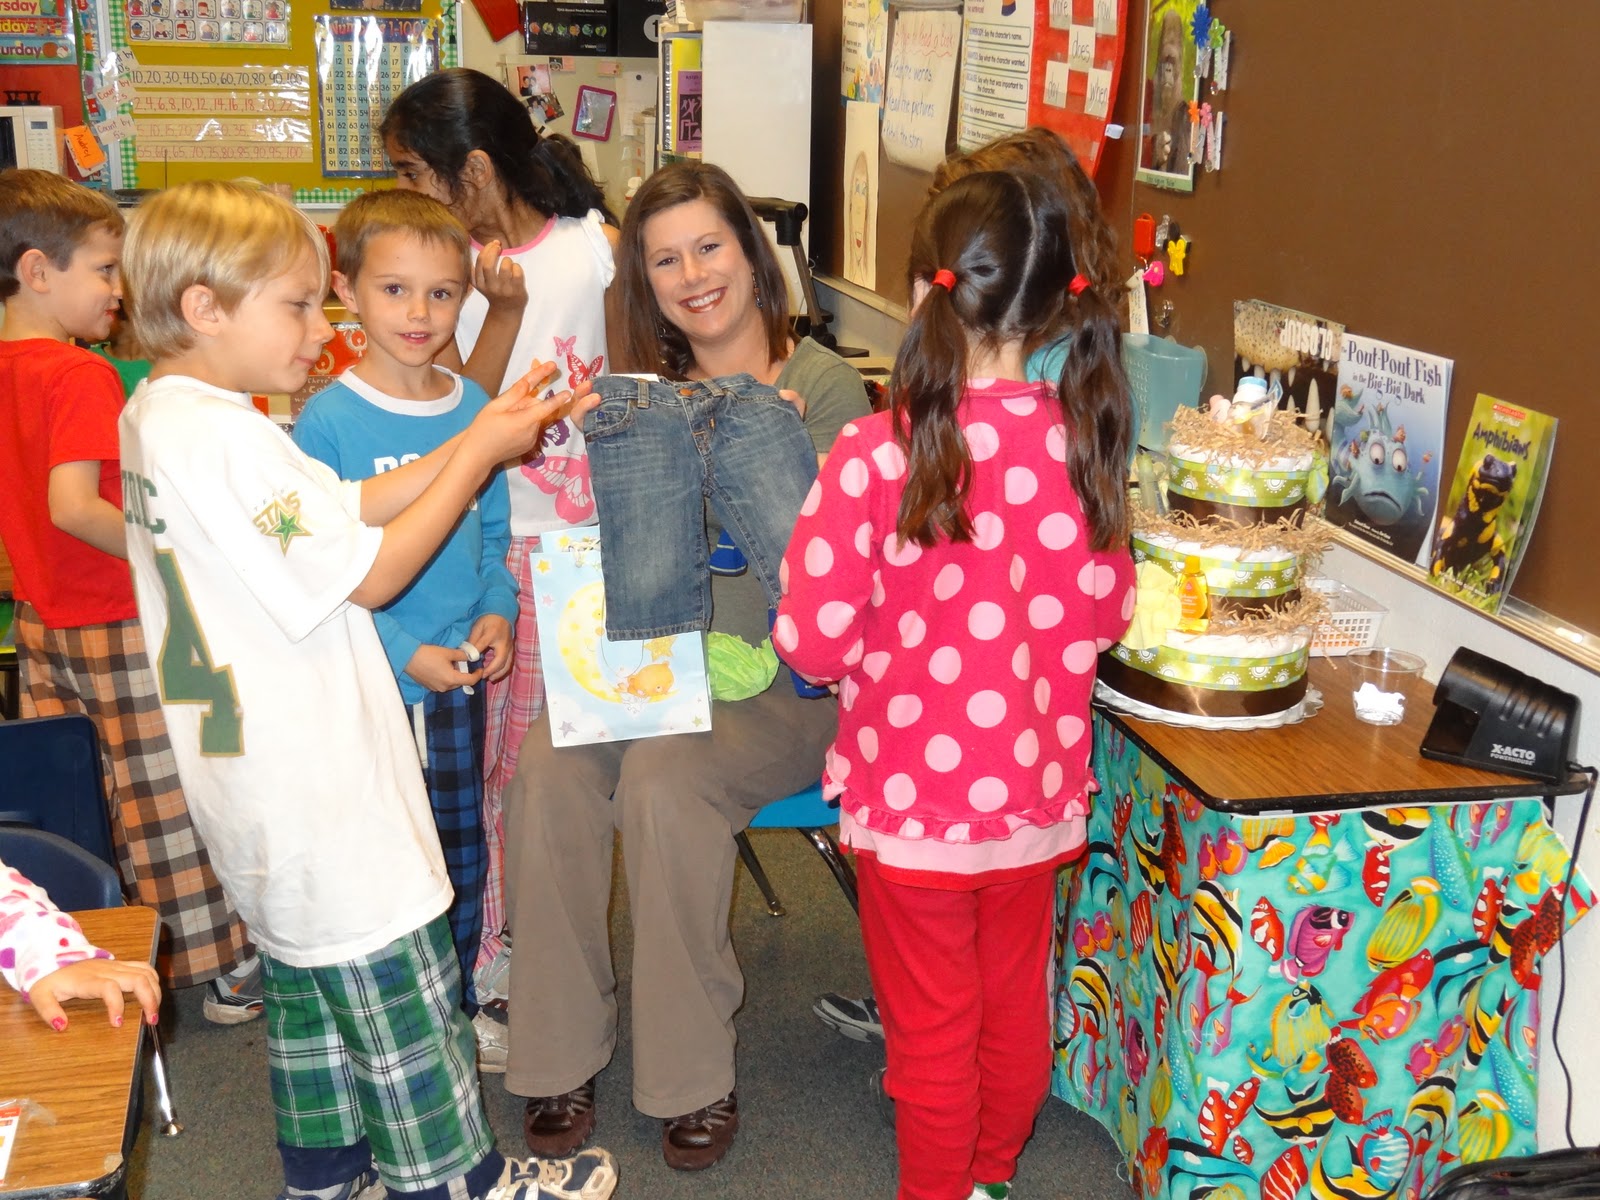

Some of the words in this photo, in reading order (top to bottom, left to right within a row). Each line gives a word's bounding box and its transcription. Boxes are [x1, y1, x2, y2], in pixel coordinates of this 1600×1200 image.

[0, 19, 29, 35] day
[0, 42, 41, 59] urday
[1072, 32, 1091, 62] does
[335, 70, 344, 78] 22
[358, 70, 367, 78] 24
[380, 70, 390, 78] 26
[392, 70, 401, 78] 27
[325, 83, 333, 91] 31
[335, 83, 345, 91] 32
[358, 83, 367, 91] 34
[381, 83, 390, 91] 36
[392, 83, 401, 91] 37
[1090, 76, 1109, 105] when
[325, 96, 333, 104] 41
[336, 96, 346, 104] 42
[347, 96, 357, 104] 43
[359, 96, 368, 104] 44
[370, 96, 380, 104] 45
[326, 109, 334, 117] 51
[337, 109, 346, 117] 52
[348, 109, 358, 117] 53
[360, 109, 369, 117] 54
[371, 109, 380, 117] 55
[328, 147, 336, 155] 81
[338, 147, 348, 155] 82
[350, 147, 359, 155] 83
[360, 147, 370, 155] 84
[372, 147, 381, 155] 85
[1347, 340, 1412, 380] Pout-Pout
[1414, 357, 1442, 388] Fish
[1366, 372, 1402, 406] Big-Big
[1404, 382, 1425, 404] Dark
[1490, 753, 1534, 766] POWERHOUSE
